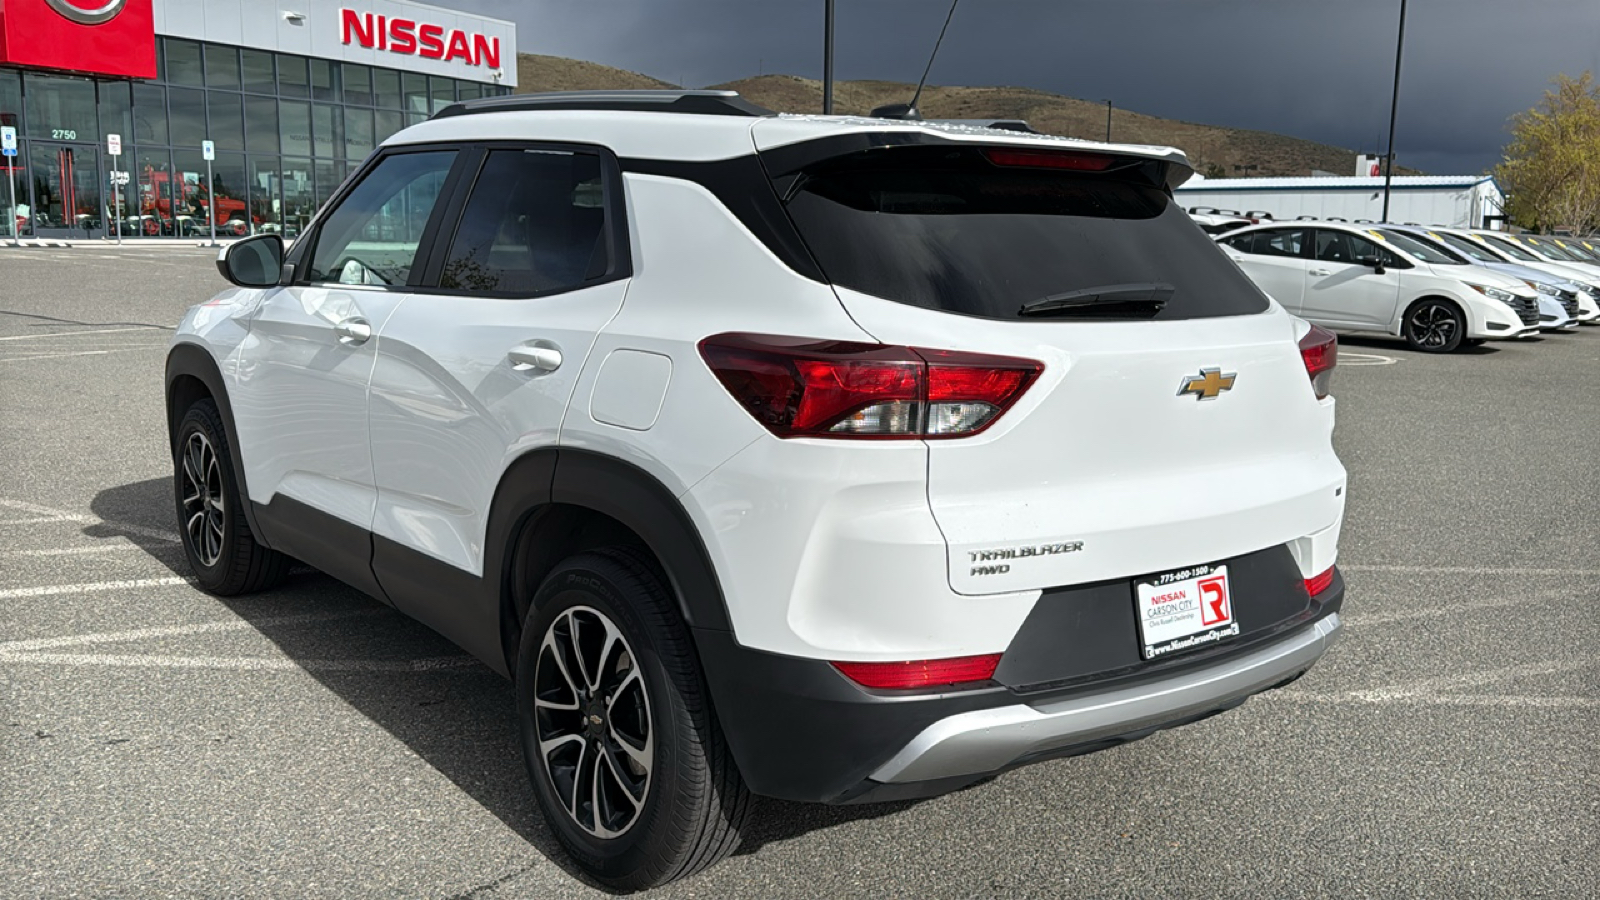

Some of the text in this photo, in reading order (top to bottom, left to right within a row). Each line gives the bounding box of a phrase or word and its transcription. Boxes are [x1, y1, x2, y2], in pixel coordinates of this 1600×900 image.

[341, 8, 500, 70] NISSAN
[52, 129, 76, 140] 2750
[968, 540, 1084, 562] TRAILBLAZER
[970, 564, 1010, 576] AWD
[1160, 565, 1209, 584] 775-600-1500
[1151, 589, 1187, 606] NISSAN
[1147, 599, 1193, 619] CARSON CITY
